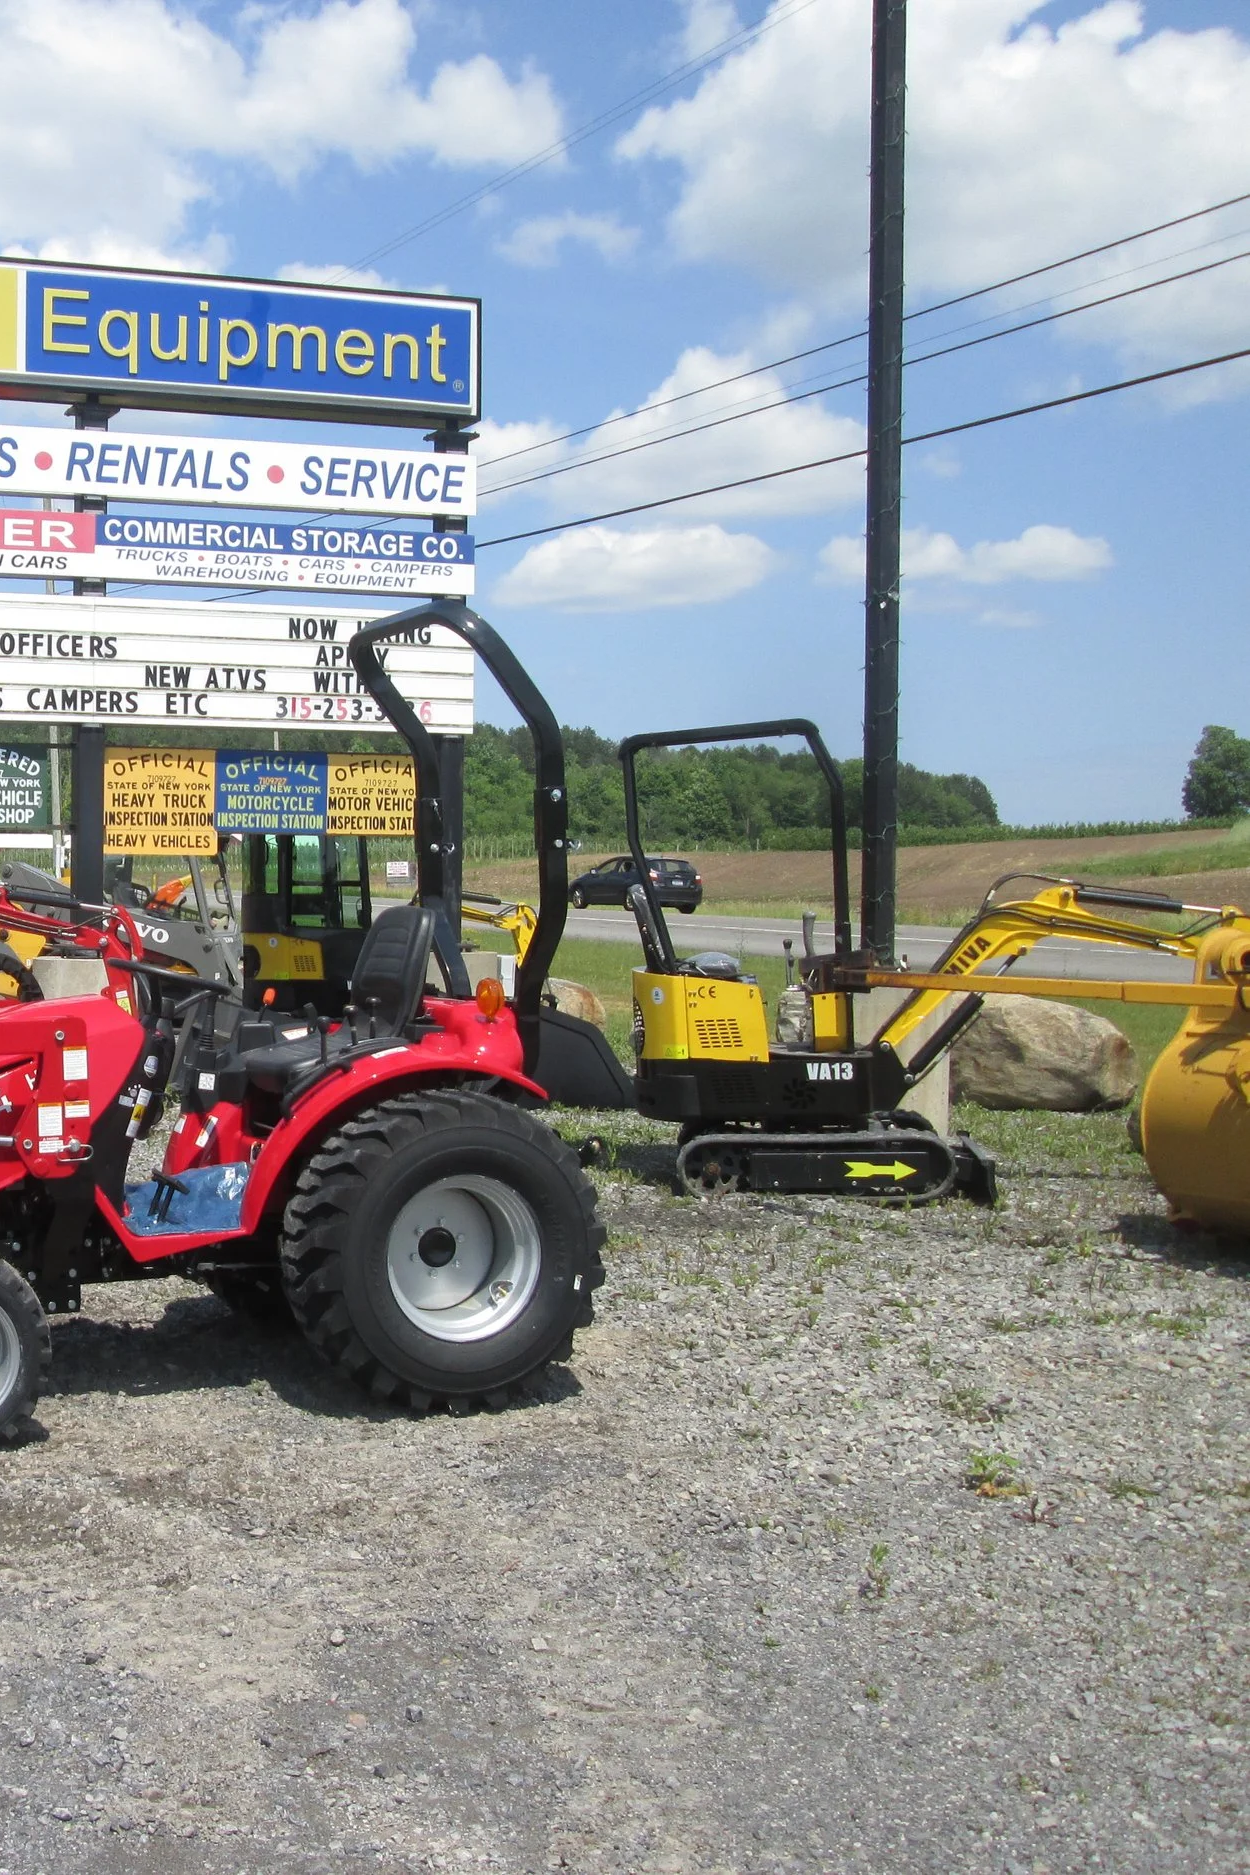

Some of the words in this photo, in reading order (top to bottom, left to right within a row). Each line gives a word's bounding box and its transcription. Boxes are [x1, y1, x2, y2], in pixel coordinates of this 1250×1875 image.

[43, 287, 447, 383] Equipment
[65, 441, 251, 491] RENTALS
[300, 455, 466, 503] SERVICE
[103, 518, 283, 550] COMMERCIAL
[291, 527, 415, 557] STORAGE
[422, 536, 465, 560] CO.
[11, 553, 68, 570] CARS
[115, 548, 189, 563] TRUCKS
[214, 553, 273, 568] BOATS
[299, 557, 346, 571] CARS
[370, 561, 453, 577] CAMPERS
[155, 564, 289, 582] WAREHOUSING
[314, 572, 417, 588] EQUIPMENT
[288, 617, 338, 641] NOW
[0, 632, 118, 659] OFFICERS
[315, 645, 389, 669] APY
[144, 665, 191, 689] NEW
[205, 668, 267, 692] ATVS
[26, 687, 138, 714] CAMPERS
[166, 692, 208, 716] ETC
[112, 753, 208, 778] OFFICIAL
[226, 755, 319, 781] OFFICIAL
[335, 759, 412, 781] OFFICIA
[13, 779, 41, 787] YORK
[107, 782, 138, 790] STATE
[141, 782, 155, 790] OF
[158, 782, 180, 790] NEW
[184, 783, 211, 791] YORK
[220, 784, 250, 793] STATE
[253, 785, 266, 793] OF
[269, 785, 292, 793] NEW
[295, 786, 321, 794] YORK
[329, 787, 357, 795] STATE
[361, 788, 374, 796] OF
[378, 788, 400, 796] NEW
[402, 789, 415, 797] YO
[365, 779, 397, 787] 7109727
[112, 793, 155, 808] HEAVY
[163, 794, 207, 808] TRUCK
[227, 795, 314, 812] MOTORCYCLE
[328, 796, 371, 811] MOTOR
[375, 797, 414, 812] VEHIC
[105, 811, 168, 826] INSPECTION
[171, 812, 214, 827] STATION
[217, 812, 278, 828] INSPECTION
[281, 814, 323, 829] STATION
[327, 815, 386, 831] INSPECTION
[107, 834, 147, 848] HEAVY
[153, 835, 211, 848] VEHICLES
[806, 1062, 854, 1080] VA13
